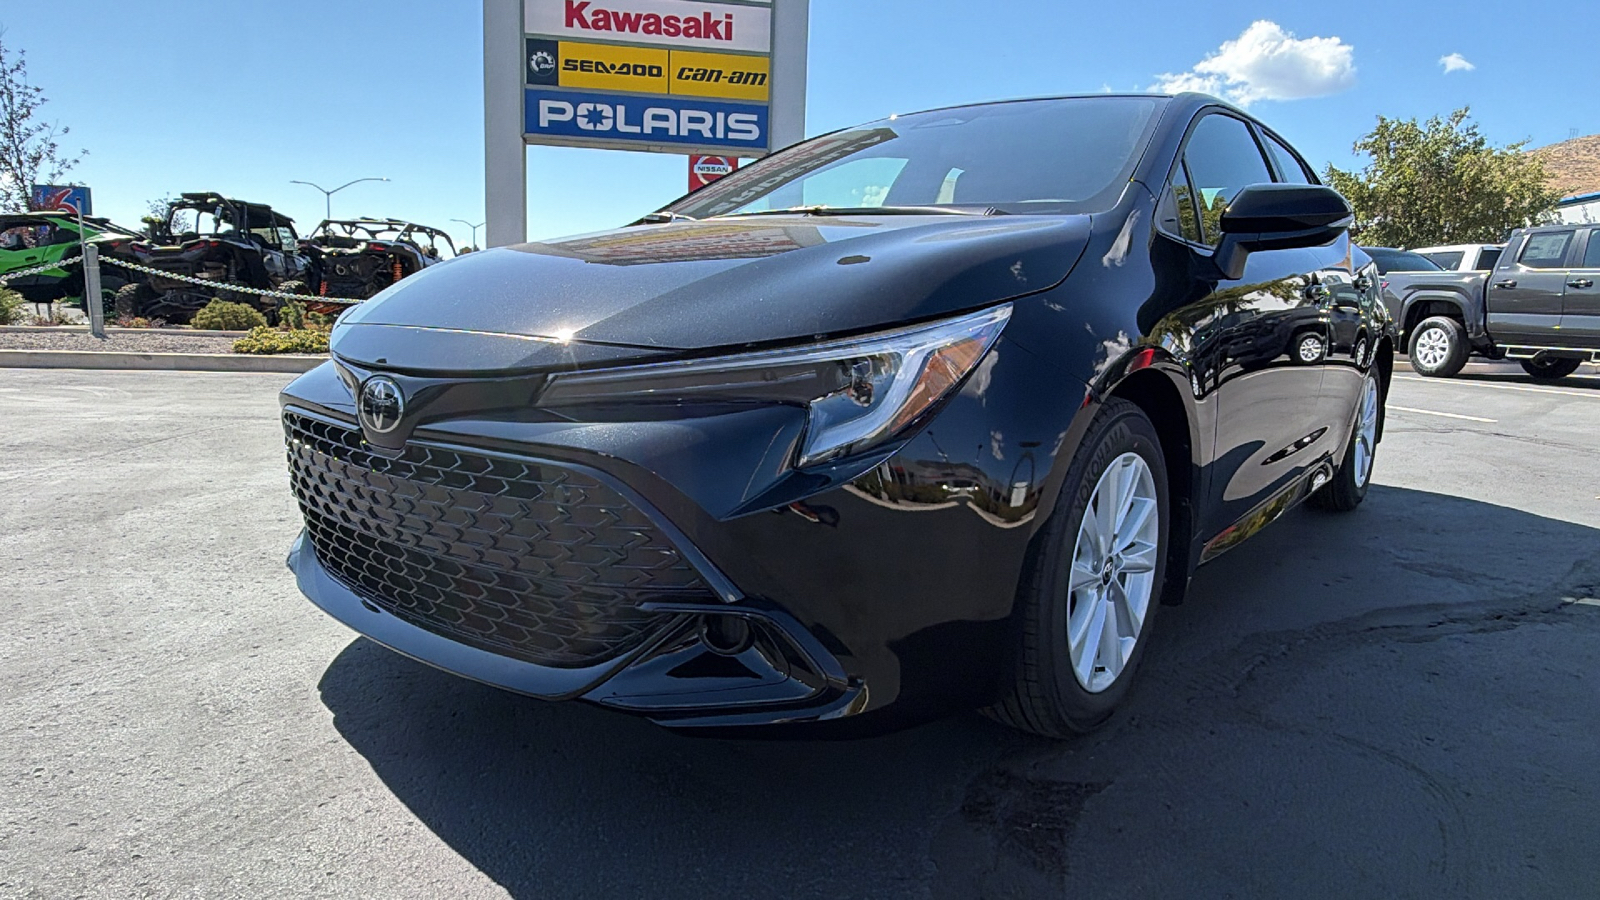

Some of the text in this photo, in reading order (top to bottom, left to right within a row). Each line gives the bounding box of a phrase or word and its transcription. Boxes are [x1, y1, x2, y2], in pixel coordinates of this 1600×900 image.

[564, 0, 733, 41] Kawasaki
[676, 67, 767, 85] can-am
[539, 99, 760, 140] POLARIS
[1075, 423, 1127, 509] YOKOHAMA
